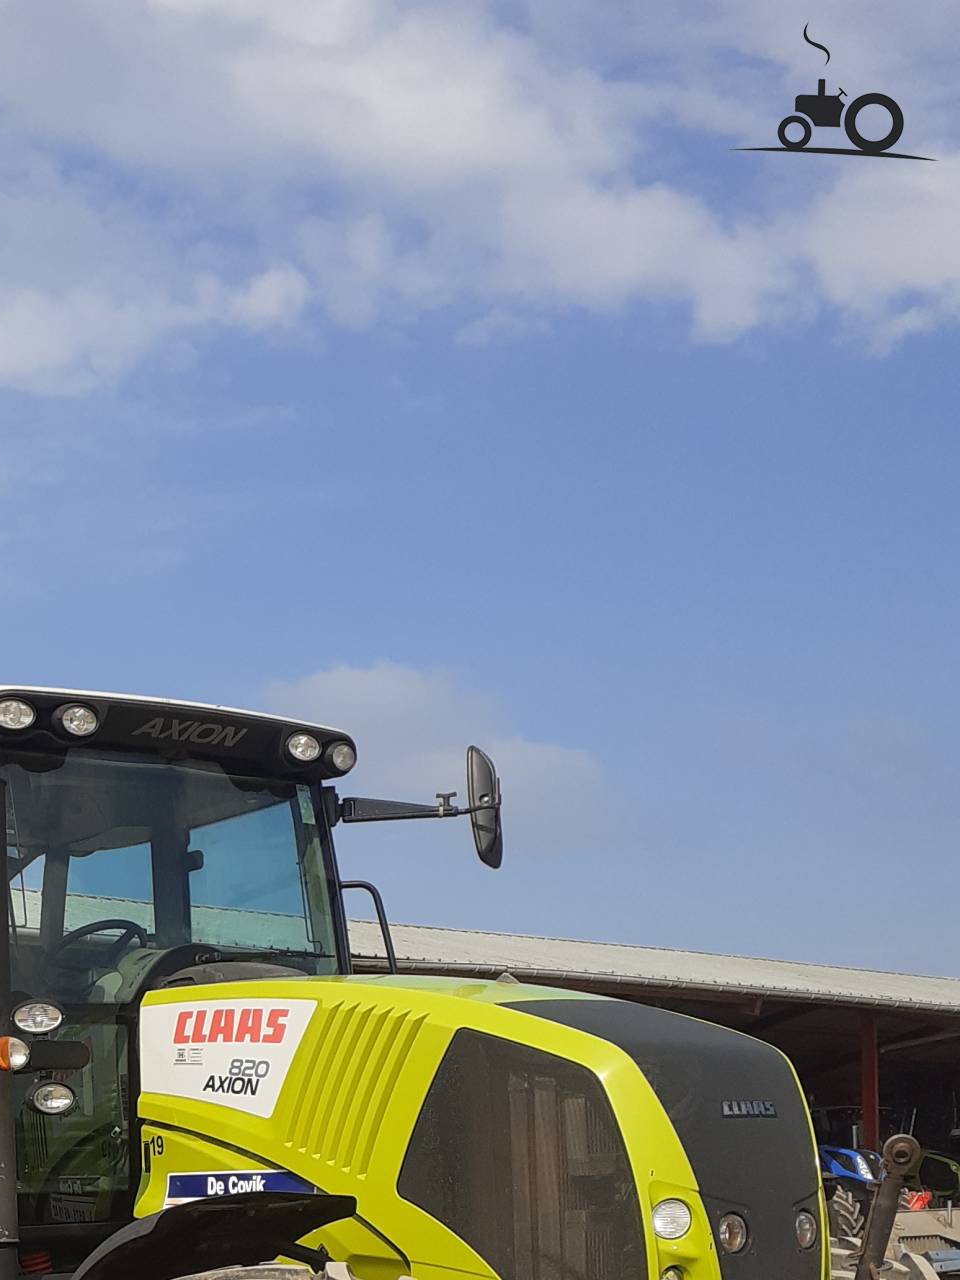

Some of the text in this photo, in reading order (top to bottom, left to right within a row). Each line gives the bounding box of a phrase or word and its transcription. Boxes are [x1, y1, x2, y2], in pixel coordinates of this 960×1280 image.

[131, 717, 248, 747] AXION
[173, 1008, 290, 1044] CLAAS
[228, 1059, 270, 1077] 820
[202, 1075, 260, 1096] AXION
[722, 1101, 776, 1116] CLAAS
[207, 1175, 266, 1195] De Covik
